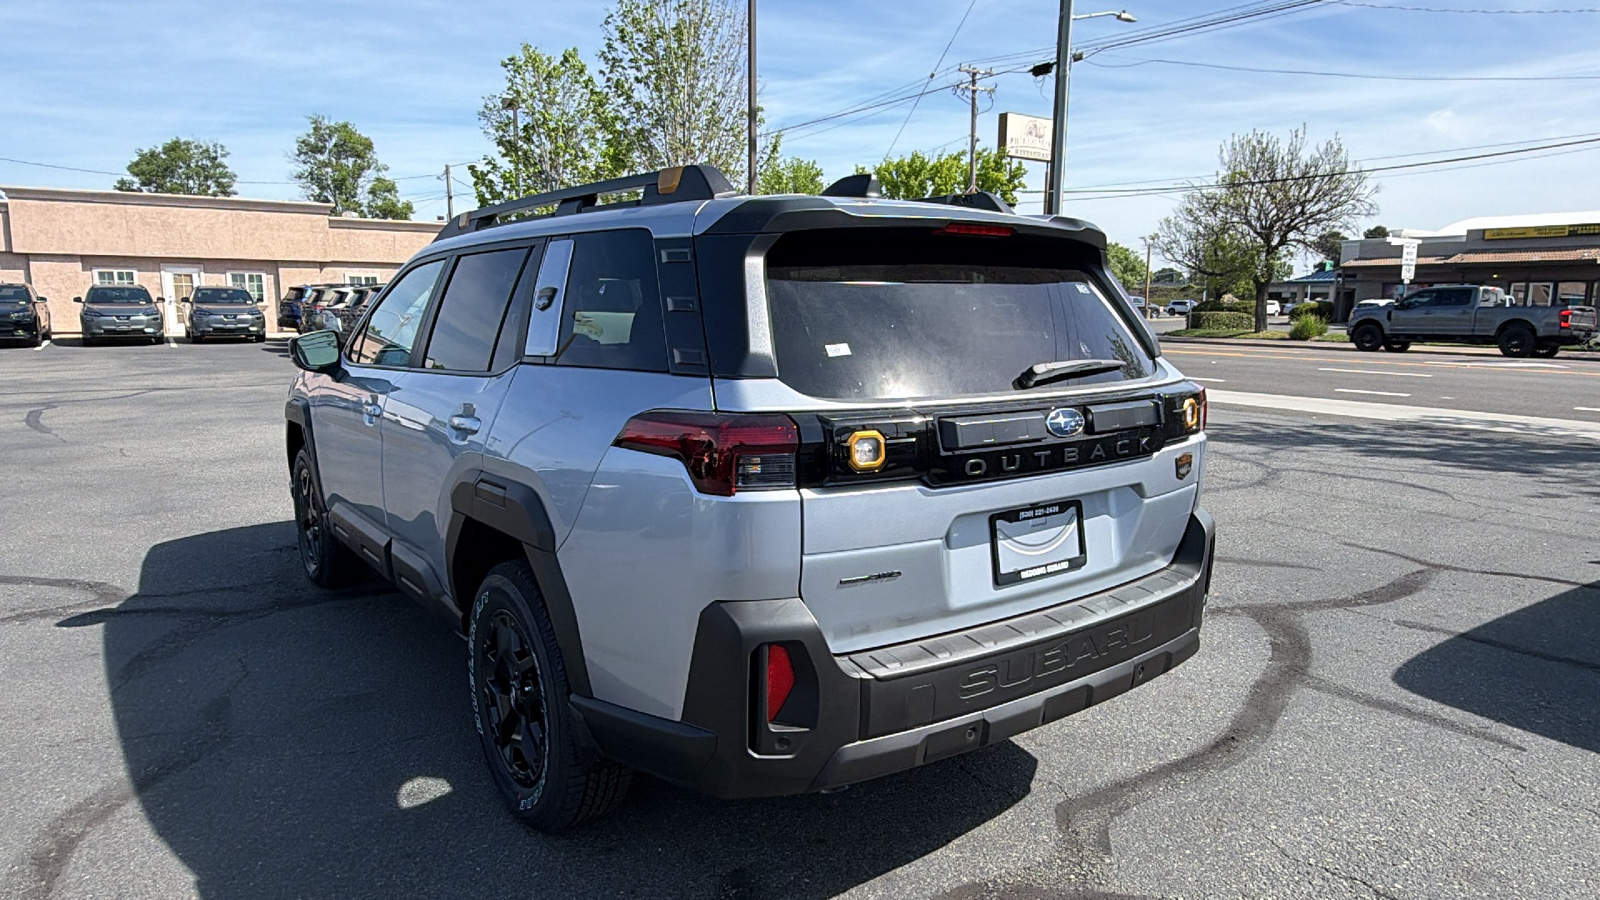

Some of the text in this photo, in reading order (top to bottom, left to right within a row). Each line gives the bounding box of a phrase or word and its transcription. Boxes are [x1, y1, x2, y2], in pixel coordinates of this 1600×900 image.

[1015, 149, 1050, 158] RESTAURAN
[964, 437, 1150, 476] OUTBACK
[959, 613, 1154, 699] SUBARU
